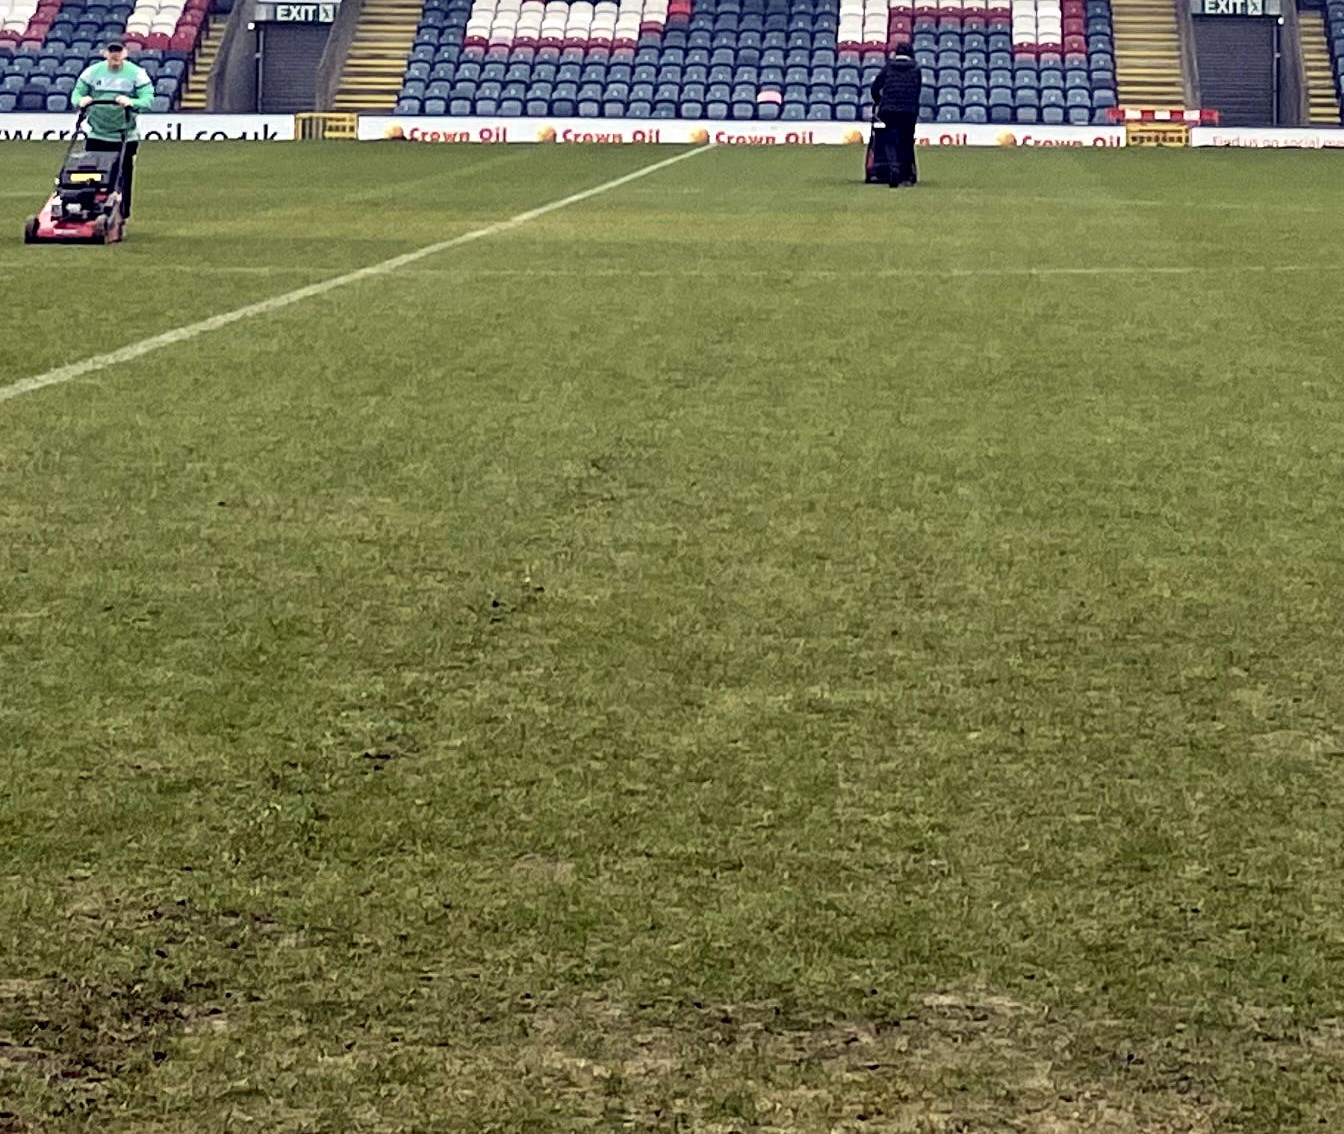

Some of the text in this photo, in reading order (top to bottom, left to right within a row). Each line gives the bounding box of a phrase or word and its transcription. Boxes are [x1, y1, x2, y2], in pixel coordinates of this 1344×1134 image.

[277, 5, 316, 22] EXIT
[715, 130, 815, 144] Crown Oil
